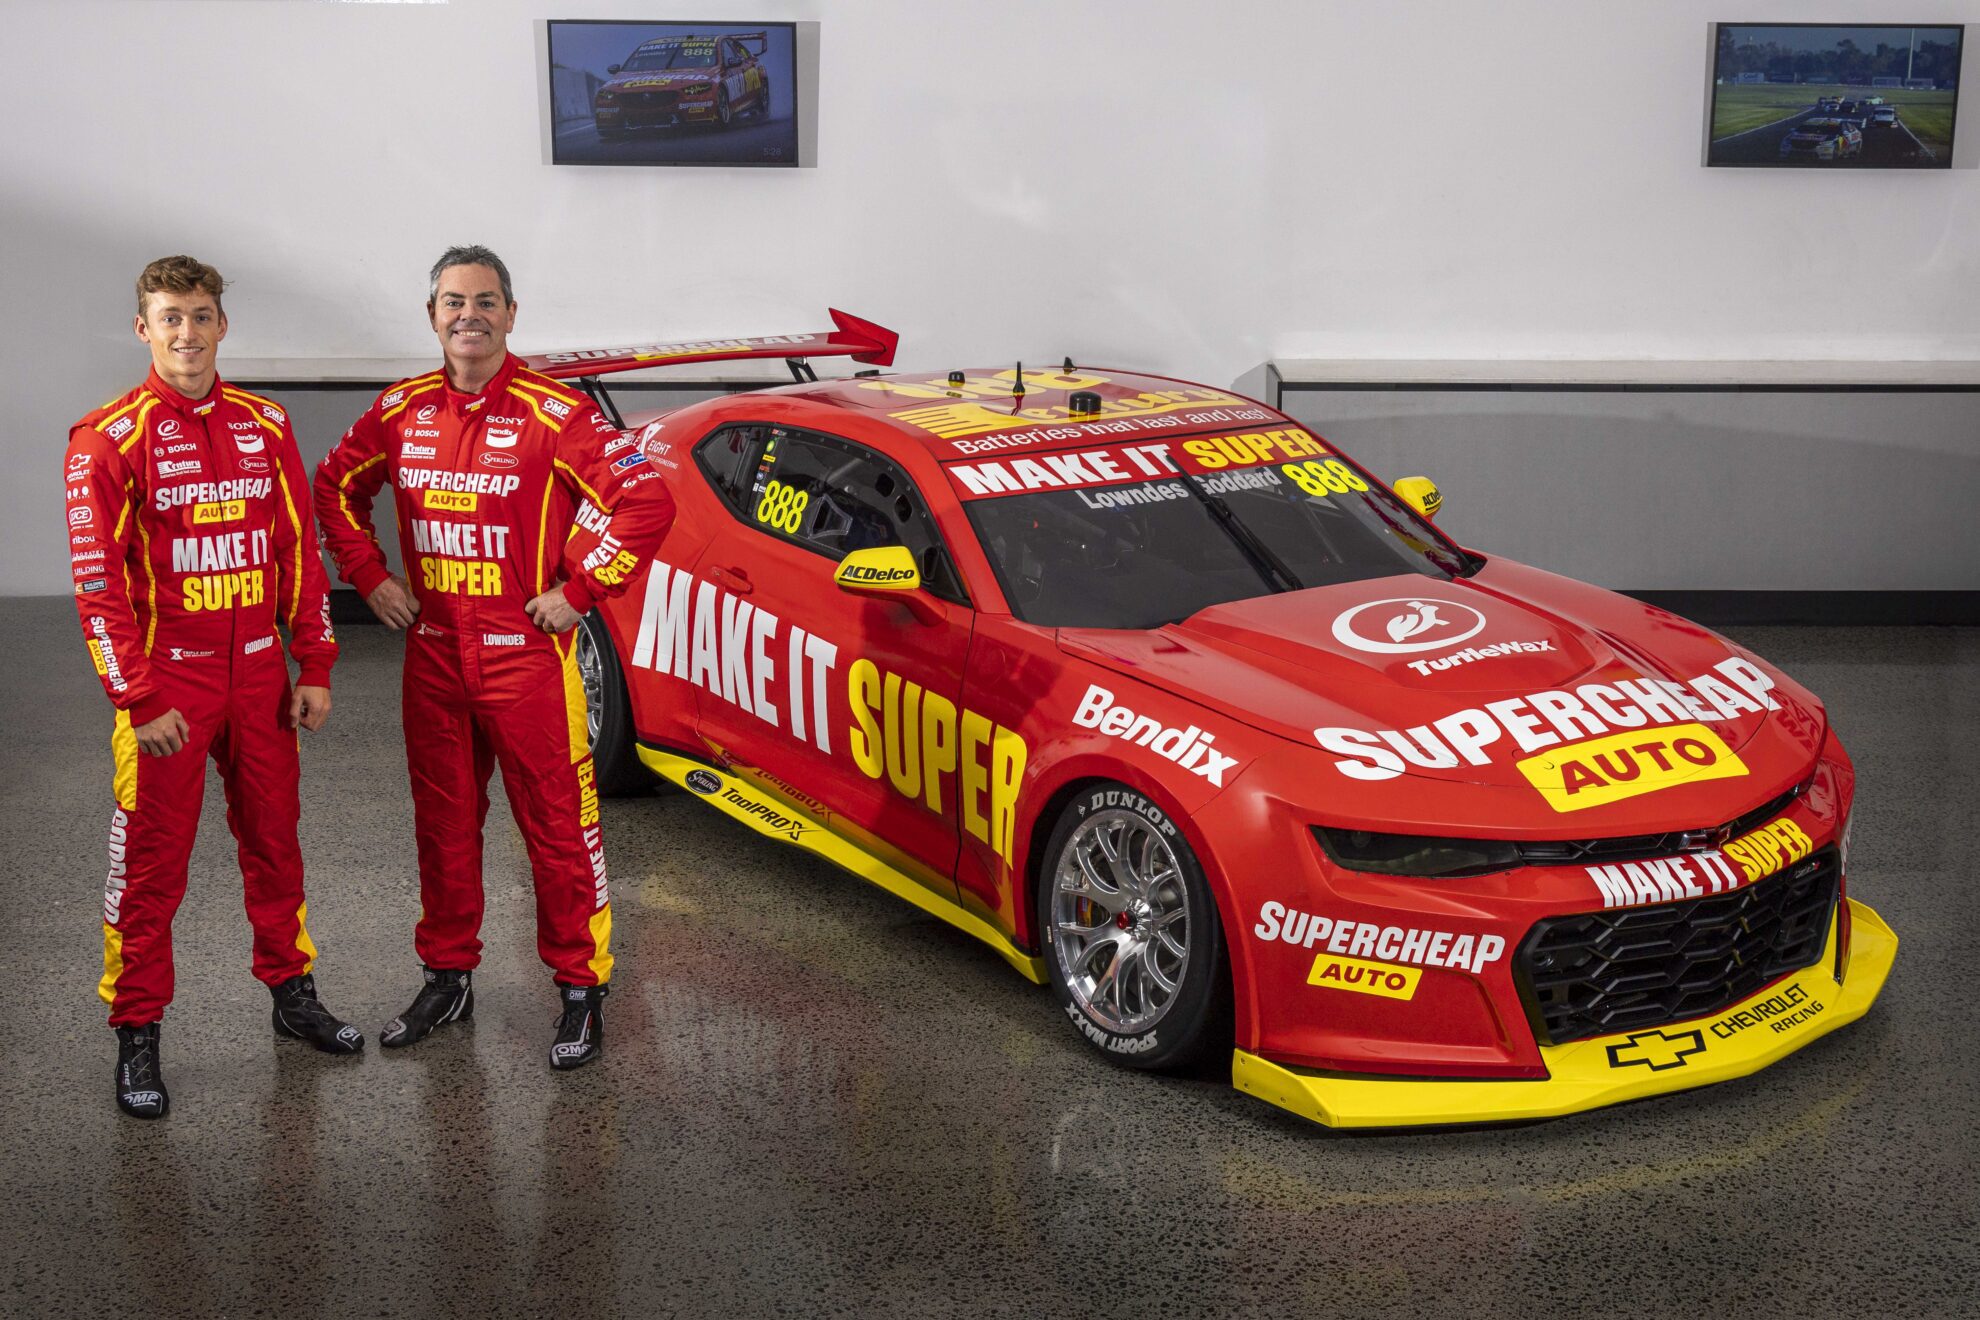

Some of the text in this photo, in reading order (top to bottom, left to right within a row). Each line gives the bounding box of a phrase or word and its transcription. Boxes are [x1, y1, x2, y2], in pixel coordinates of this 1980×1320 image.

[263, 406, 285, 422] OMP
[381, 394, 404, 406] OMP
[543, 400, 570, 416] OMP
[109, 418, 132, 437] OMP
[228, 421, 260, 431] SONY
[414, 429, 440, 438] BOSCH
[485, 415, 525, 426] SONY
[487, 427, 513, 435] Bendix
[951, 407, 1273, 455] Batteries that last and last
[167, 443, 197, 453] BOSCH
[483, 453, 515, 465] SPERLING
[646, 440, 672, 456] EIGHT
[949, 429, 1328, 495] MAKE IT SUPER
[155, 477, 272, 511] SUPERCHEAP
[399, 467, 520, 497] SUPERCHEAP
[1075, 481, 1190, 510] Lowndes
[1281, 460, 1369, 497] 888
[199, 505, 239, 519] AUTO
[430, 495, 471, 506] AUTO
[575, 498, 613, 537] HEA
[758, 480, 809, 534] 888
[172, 528, 268, 573] MAKE IT
[411, 519, 509, 559] MAKE IT
[421, 557, 502, 596] SUPER
[841, 565, 915, 581] ACDelco
[183, 569, 264, 612] SUPER
[90, 616, 128, 692] SUPERCHEAP
[91, 643, 106, 670] AUTO
[244, 635, 273, 655] GODDARD
[483, 633, 525, 646] LOWNDES
[1407, 637, 1557, 676] TurtleWax
[631, 558, 1027, 871] MAKE IT SUPER
[1313, 655, 1783, 781] SUPERCHEAP
[1072, 684, 1239, 789] Bendix
[1560, 737, 1717, 795] AUTO
[1091, 790, 1176, 837] DUNLOP
[577, 757, 609, 909] MAKE IT SUPER
[1584, 856, 1704, 908] MAKE
[1690, 850, 1738, 893] IT
[1723, 817, 1813, 882] SUPER
[1254, 900, 1506, 974] SUPERCHEAP
[1320, 963, 1406, 990] AUTO
[569, 991, 587, 999] OMP
[1709, 983, 1809, 1039] CHEVROLET
[1064, 1001, 1158, 1054] SPORT MAXX
[1770, 1000, 1824, 1034] RACING
